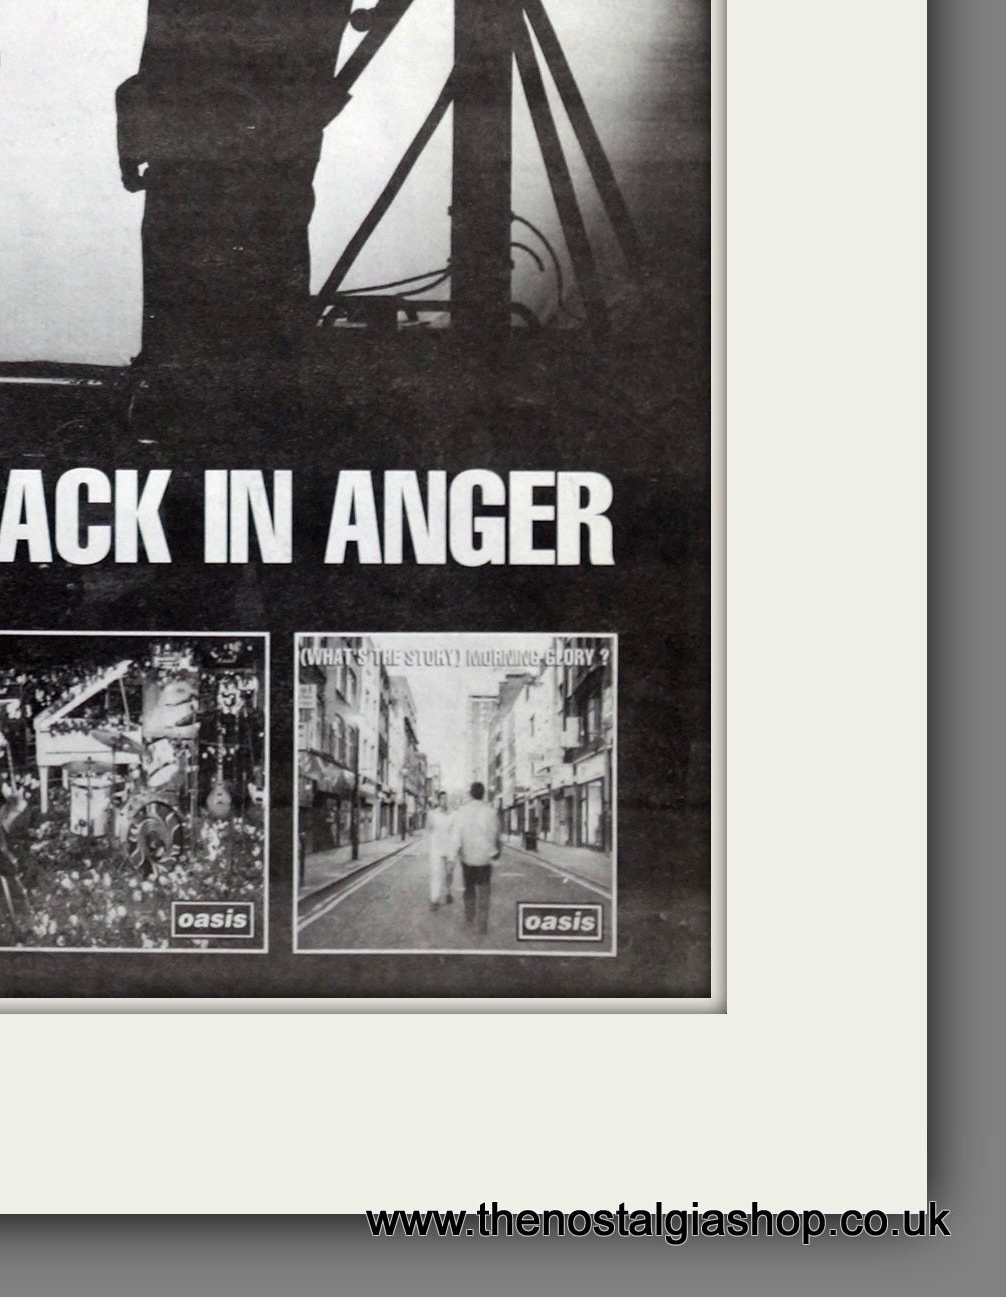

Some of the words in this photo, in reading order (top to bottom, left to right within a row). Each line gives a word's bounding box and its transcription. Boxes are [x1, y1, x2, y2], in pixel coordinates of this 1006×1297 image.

[204, 469, 292, 564] IN
[324, 468, 615, 567] ANGER
[300, 647, 367, 668] (WHAT'S
[373, 648, 403, 668] THE
[404, 648, 462, 668] STORY)
[466, 648, 542, 668] MORNING
[544, 648, 594, 668] GLORY
[178, 908, 248, 929] oasis
[524, 910, 596, 932] oasis
